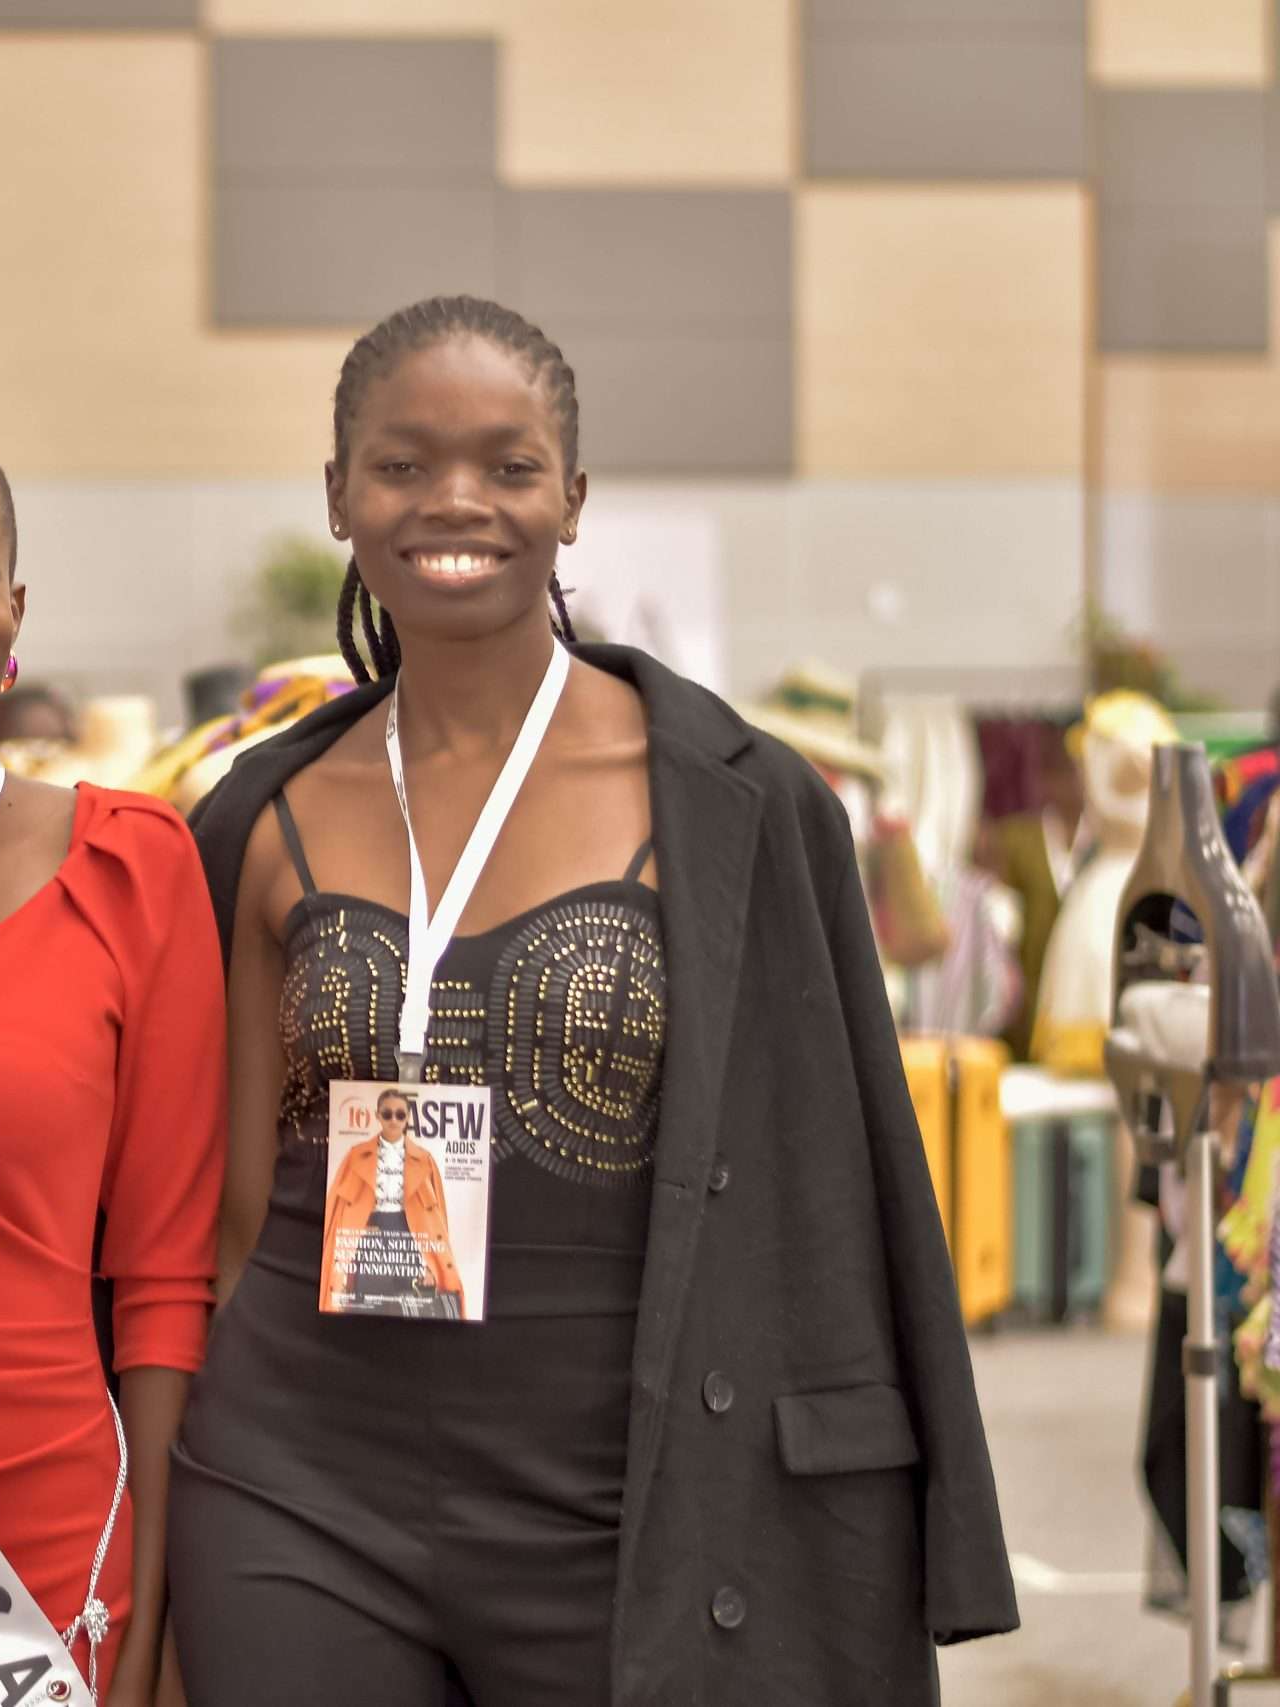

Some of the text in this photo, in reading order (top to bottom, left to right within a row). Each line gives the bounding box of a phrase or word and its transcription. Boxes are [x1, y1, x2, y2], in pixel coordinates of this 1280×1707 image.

[407, 1101, 484, 1140] ASFW
[445, 1141, 476, 1154] ADDIS
[359, 1263, 426, 1277] INNOVATION
